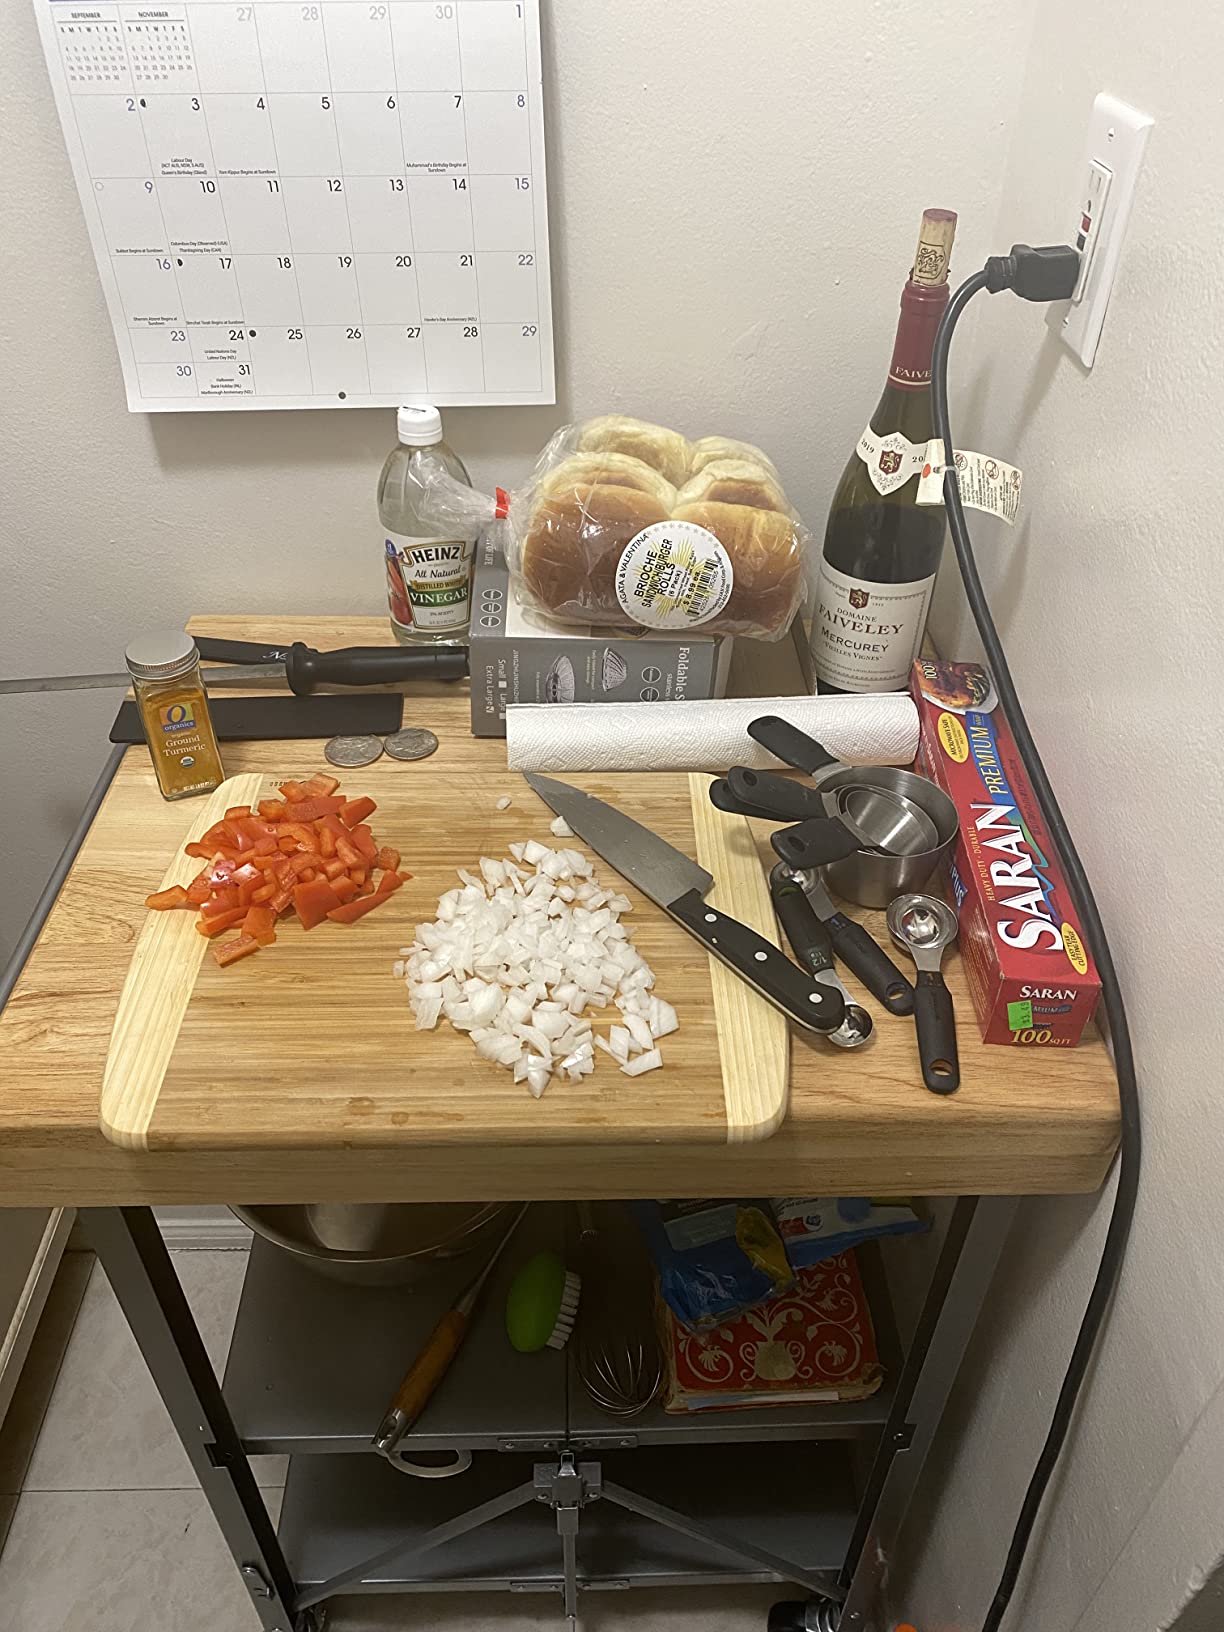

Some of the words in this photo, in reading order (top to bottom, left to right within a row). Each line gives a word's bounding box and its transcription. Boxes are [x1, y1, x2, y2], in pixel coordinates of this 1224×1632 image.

[236, 8, 253, 22] 27
[302, 7, 318, 20] 28
[370, 6, 386, 19] 29
[435, 5, 453, 19] 30
[516, 4, 522, 18] 1
[127, 99, 135, 111] 2
[192, 98, 200, 110] 3
[257, 98, 265, 110] 4
[321, 97, 330, 109] 5
[387, 96, 395, 109] 6
[454, 96, 461, 108] 7
[517, 95, 525, 107] 8
[144, 182, 153, 193] 9
[200, 181, 215, 192] 10
[268, 181, 279, 192] 11
[327, 180, 341, 192] 12
[390, 180, 404, 191] 13
[452, 179, 466, 190] 14
[515, 178, 529, 189] 15
[156, 259, 171, 270] 16
[219, 258, 232, 269] 17
[278, 258, 291, 268] 18
[338, 256, 352, 268] 19
[396, 256, 412, 267] 20
[460, 255, 473, 266] 21
[518, 255, 533, 266] 22
[171, 331, 186, 342] 23
[229, 330, 244, 341] 24
[288, 329, 303, 340] 25
[346, 328, 361, 339] 26
[407, 327, 420, 338] 27
[464, 327, 478, 337] 28
[522, 326, 537, 337] 29
[177, 366, 191, 376] 30
[239, 365, 250, 375] 31
[896, 366, 932, 378] FAIVE
[412, 546, 460, 564] HEINZ
[620, 533, 649, 573] VALENTINA
[415, 570, 427, 578] All
[430, 564, 461, 578] Natural
[634, 550, 658, 598] BRIOCHE
[641, 538, 673, 608] SANDWICH/BURGER
[416, 582, 444, 590] DISTILLED
[657, 563, 676, 596] ROLLS
[671, 570, 683, 589] Pack)
[410, 588, 468, 603] VINEGAR
[618, 582, 628, 604] AGATA
[686, 583, 697, 600] 8.99
[819, 604, 904, 636] FAIVELEY
[837, 607, 878, 623] DOMAINE
[821, 626, 889, 653] MERCUREY
[486, 666, 494, 684] Extra
[498, 659, 506, 678] Small
[676, 647, 690, 692] Foldable
[922, 666, 938, 679] 100
[485, 685, 494, 706] Large
[499, 693, 507, 712] Large
[164, 721, 194, 732] organics
[166, 734, 200, 748] Ground
[163, 744, 206, 757] Turmeric
[969, 726, 1008, 794] PREMIUM
[967, 827, 982, 856] DURABLE
[978, 859, 988, 877] DUTY
[970, 803, 1064, 951] SARAN
[984, 877, 996, 902] HEAVY
[813, 957, 827, 966] 1/2
[1020, 986, 1077, 1000] SARAN
[1011, 1030, 1052, 1044] 100
